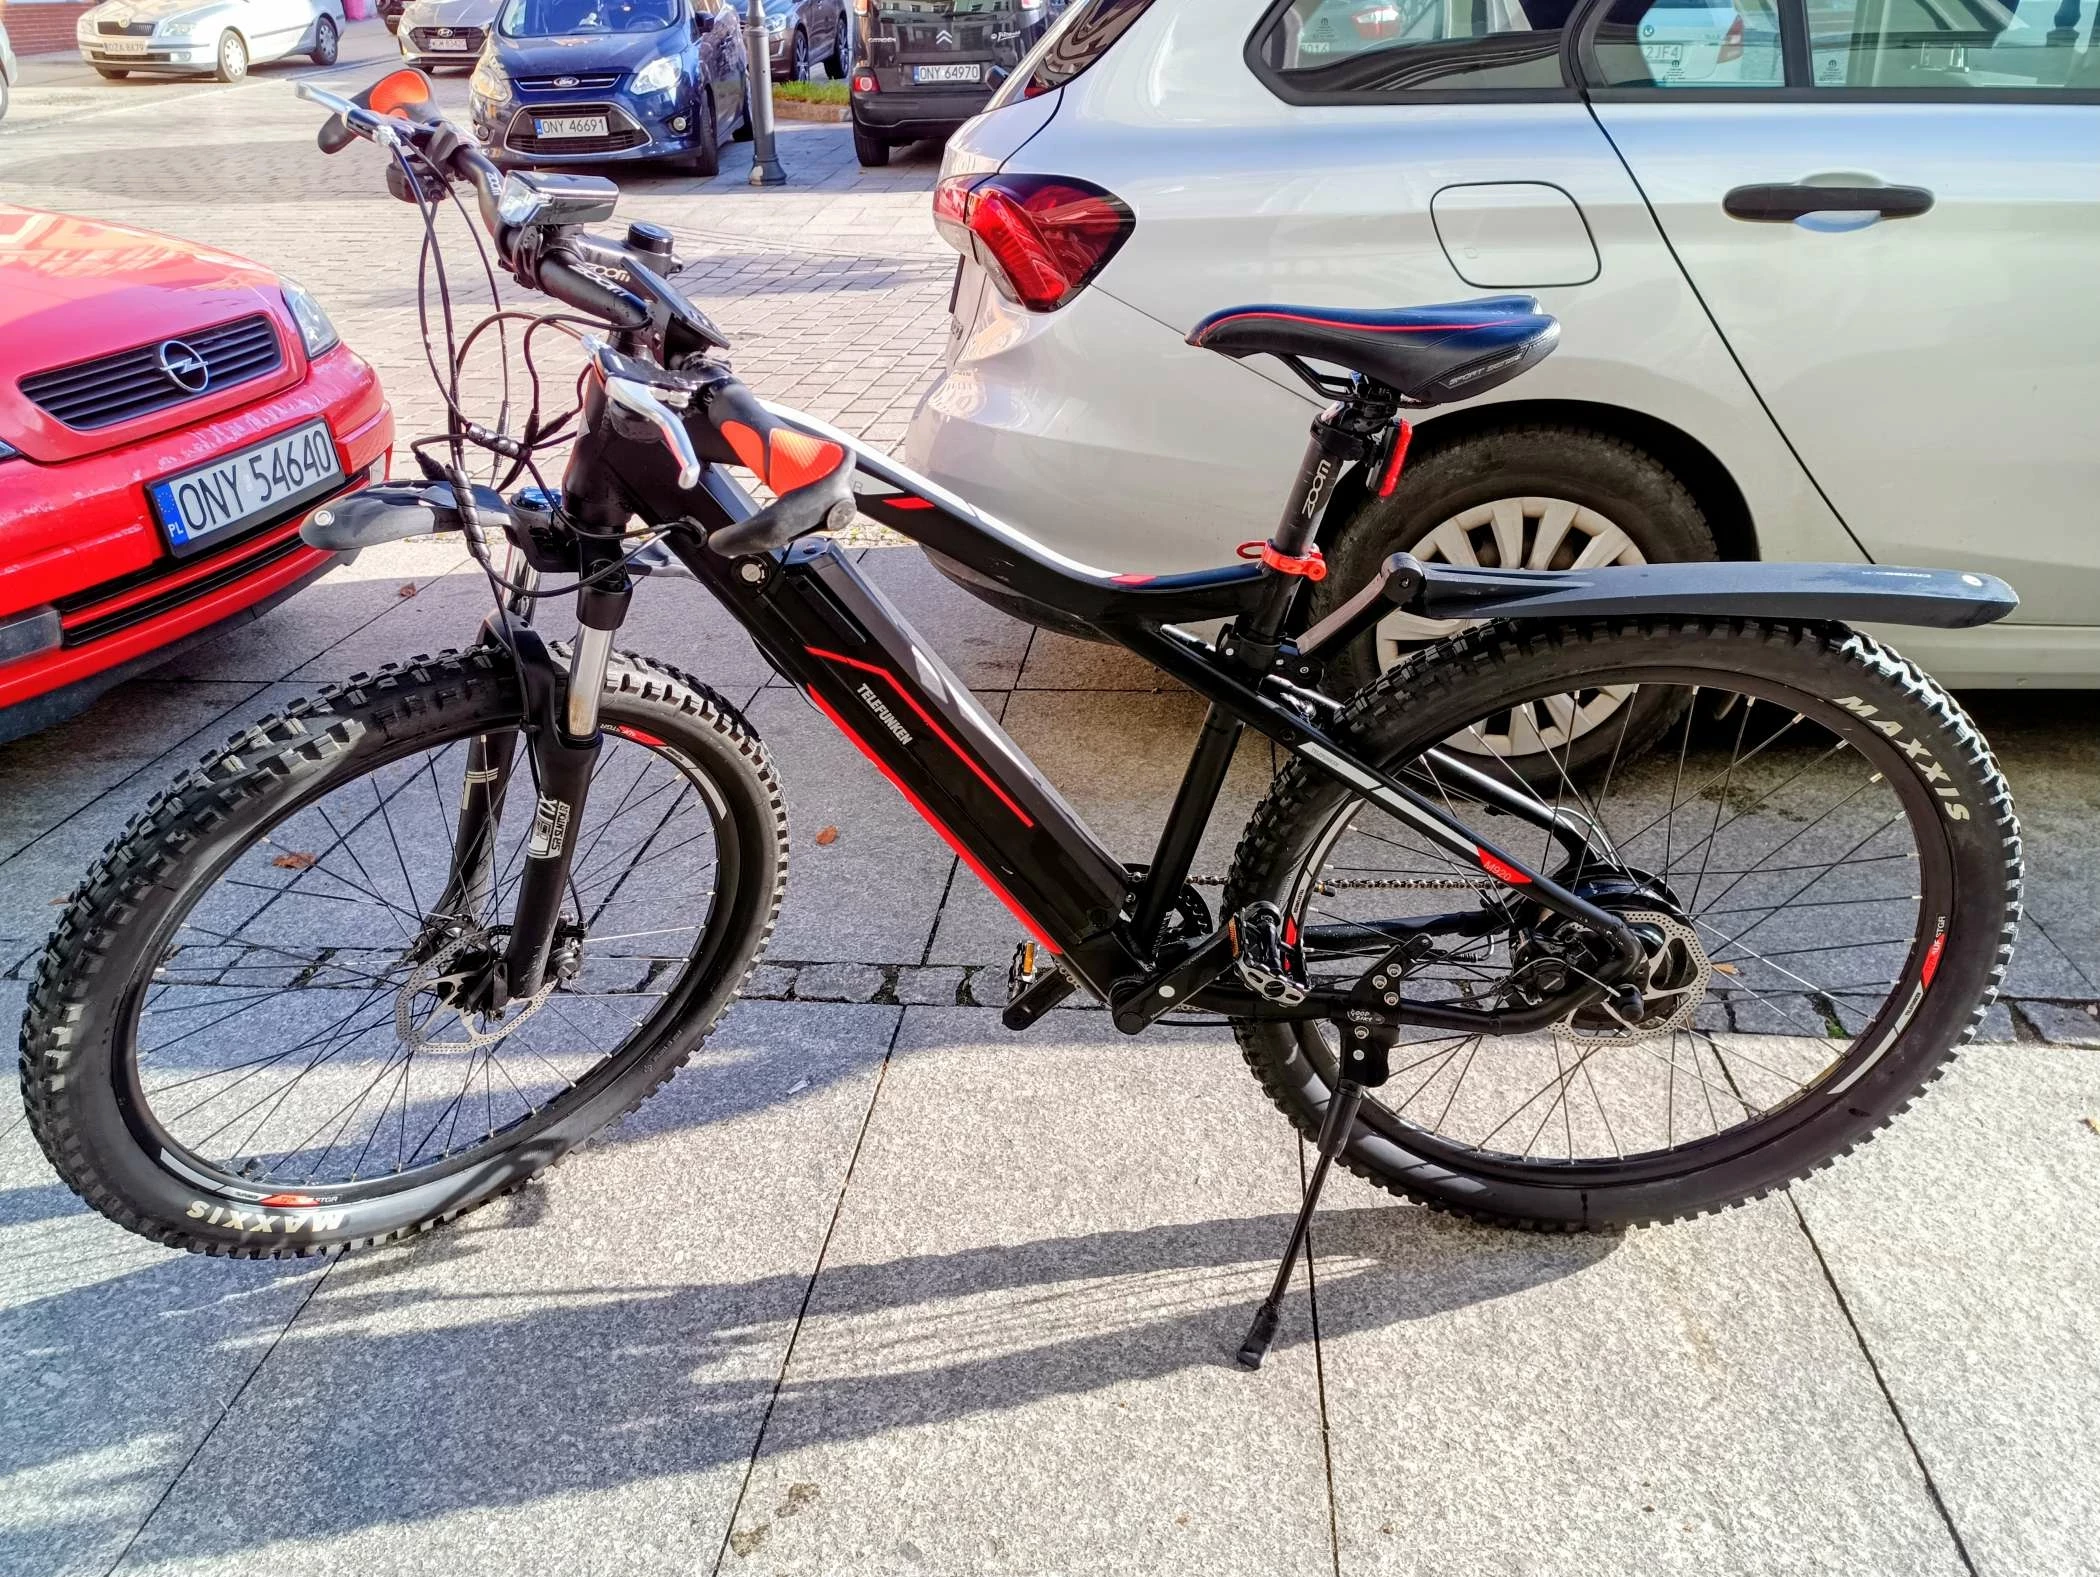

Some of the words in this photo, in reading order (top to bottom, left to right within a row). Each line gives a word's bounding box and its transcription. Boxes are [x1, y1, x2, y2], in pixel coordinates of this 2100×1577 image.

[920, 67, 943, 79] ONY
[944, 66, 979, 79] 64970
[542, 120, 564, 133] ONY
[569, 118, 605, 132] 46691
[178, 464, 244, 531] ONY
[248, 430, 332, 503] 54640
[167, 522, 184, 537] PL
[857, 682, 913, 746] TELEFUNKEN
[1831, 695, 1971, 821] MAXXIS
[1483, 861, 1512, 881] M920
[185, 1199, 347, 1234] MAXXIS
